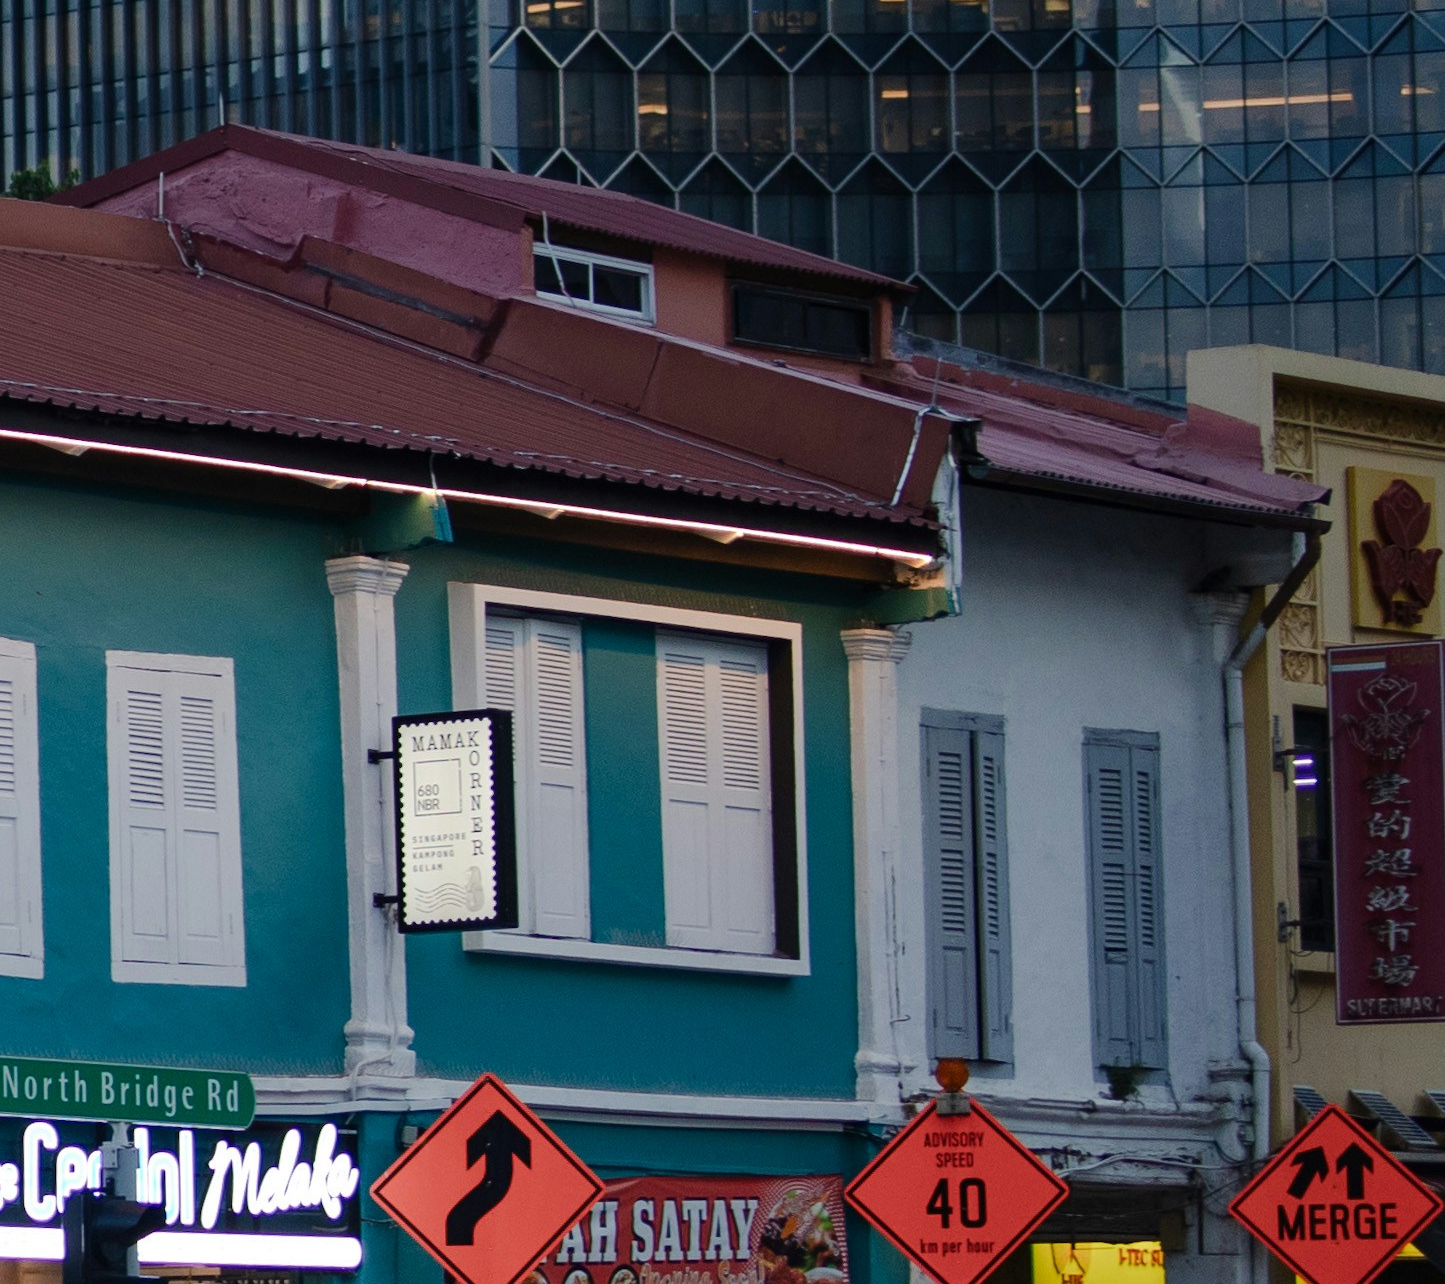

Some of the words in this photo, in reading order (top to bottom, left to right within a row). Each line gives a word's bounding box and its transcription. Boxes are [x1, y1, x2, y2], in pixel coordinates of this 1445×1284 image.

[412, 730, 480, 753] MAMAK
[417, 783, 440, 797] 680
[417, 798, 440, 812] NBR
[412, 832, 467, 844] SINGAPORE
[412, 849, 455, 860] KAMPONG
[412, 863, 443, 873] GELAM
[2, 1065, 87, 1103] North
[101, 1071, 194, 1117] Bridge
[207, 1078, 239, 1113] Rd
[924, 1131, 984, 1147] ADVISORY
[936, 1152, 974, 1168] SPEED
[201, 1122, 360, 1230] Melaka
[926, 1177, 987, 1229] 40
[630, 1198, 759, 1263] SATAY
[1277, 1202, 1398, 1241] MERGE
[920, 1238, 938, 1254] km
[942, 1241, 962, 1257] per
[966, 1237, 995, 1253] hour
